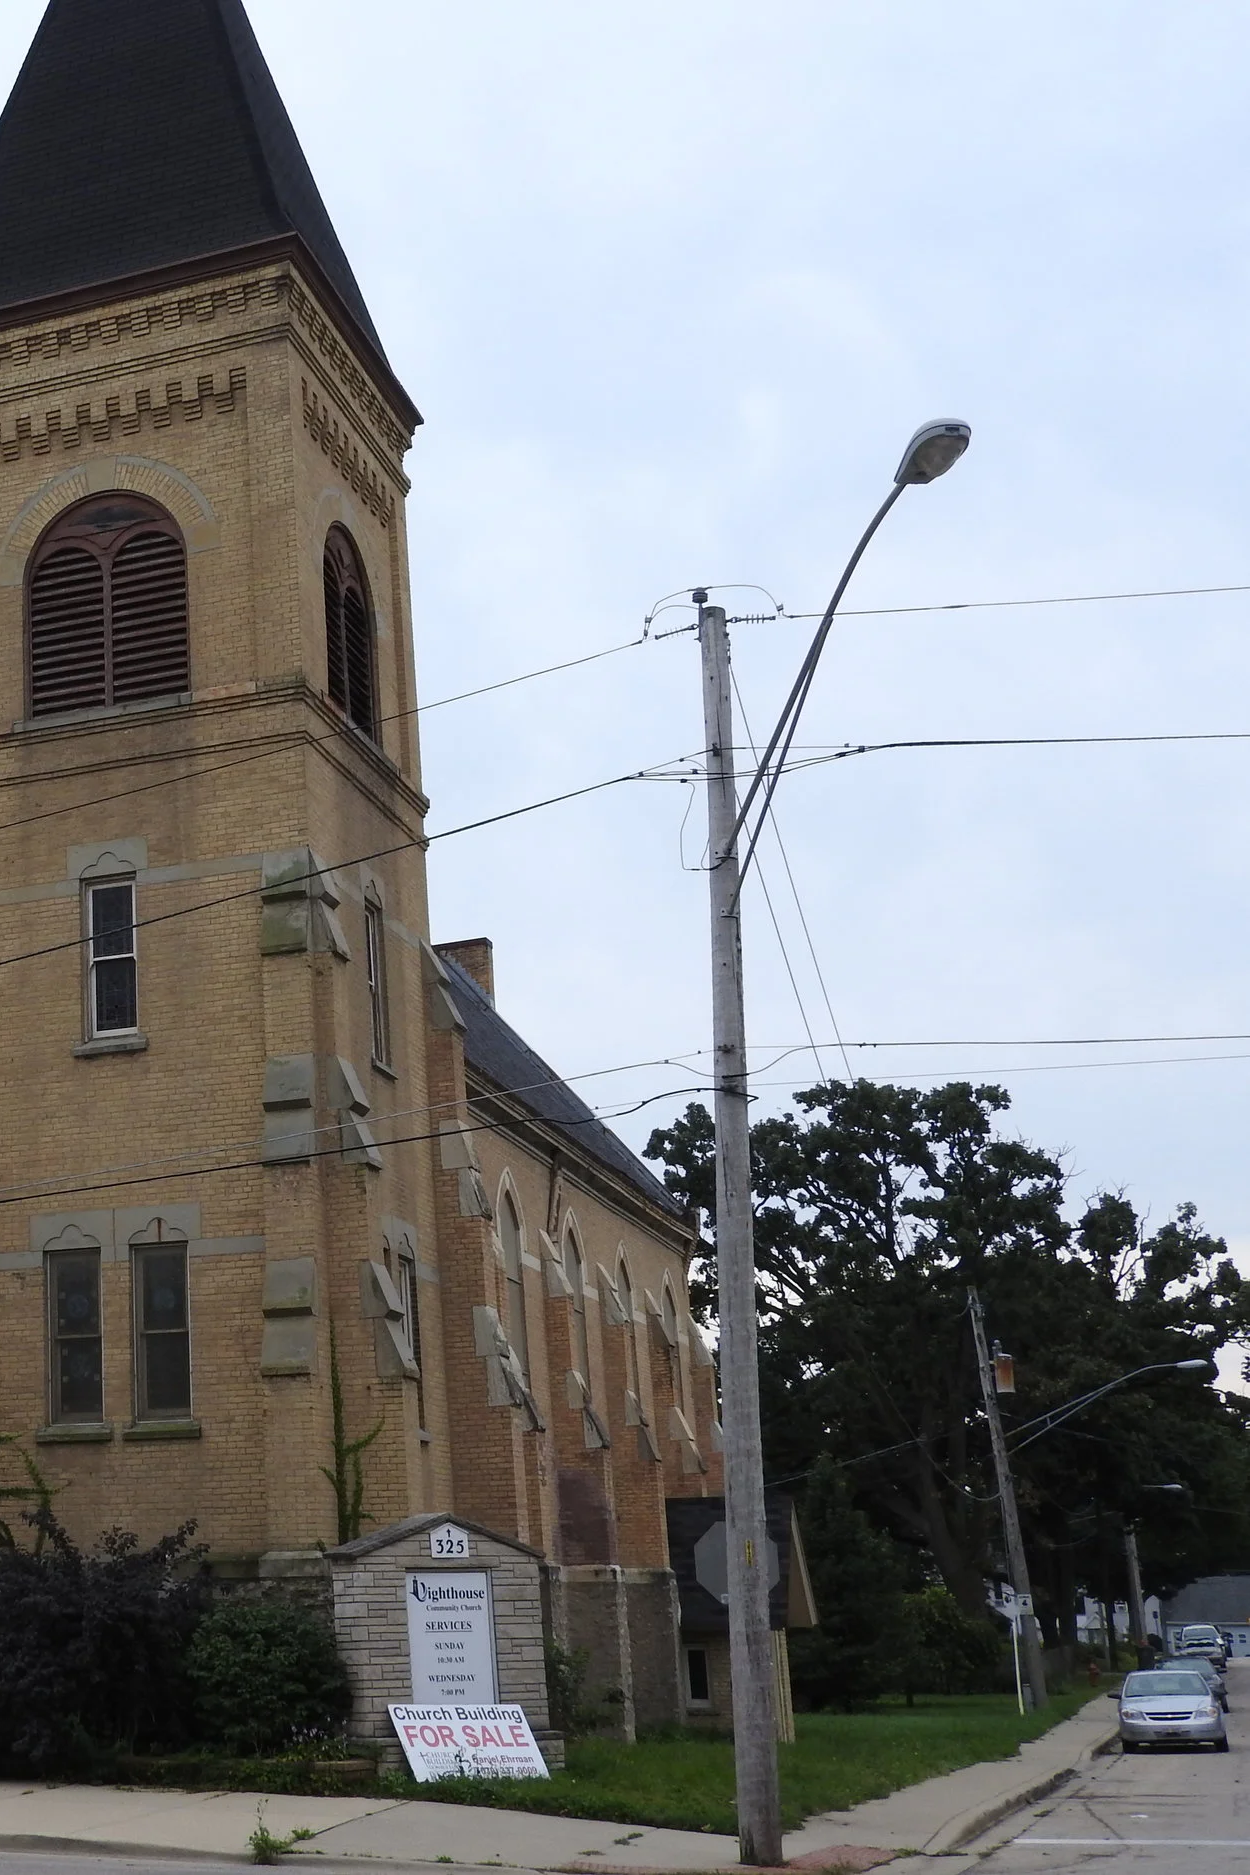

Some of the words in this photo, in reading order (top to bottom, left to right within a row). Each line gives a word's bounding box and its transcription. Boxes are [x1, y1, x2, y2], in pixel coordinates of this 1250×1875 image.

[436, 1539, 464, 1554] 325
[410, 1575, 485, 1602] Lighthouse
[426, 1605, 459, 1613] Community
[425, 1621, 472, 1631] SERVICES
[434, 1642, 465, 1650] SUNDAY
[428, 1674, 476, 1682] WEDNESDAY
[393, 1707, 452, 1721] Church
[454, 1707, 523, 1724] Building
[402, 1725, 460, 1748] FOR
[461, 1725, 530, 1748] SALE
